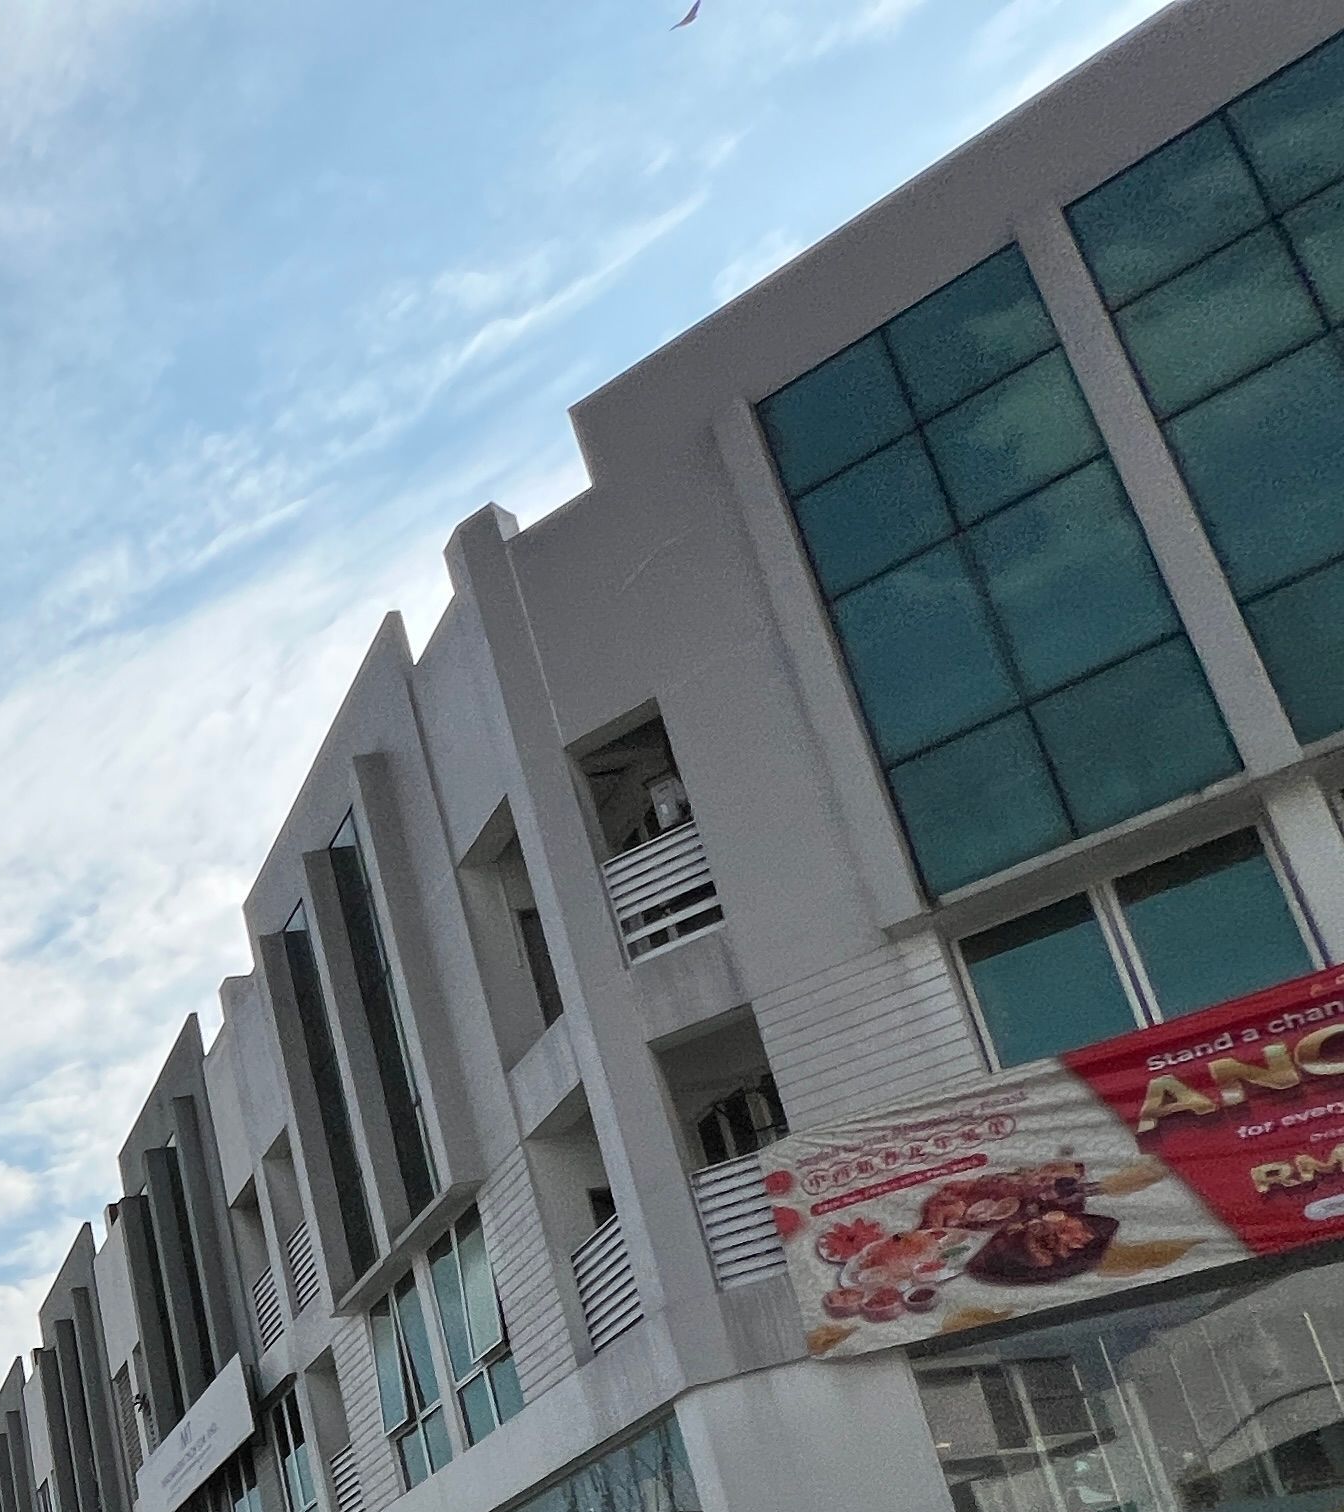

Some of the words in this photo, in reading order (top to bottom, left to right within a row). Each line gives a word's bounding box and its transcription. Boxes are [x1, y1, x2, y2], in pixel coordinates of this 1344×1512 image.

[1146, 1031, 1235, 1072] Stand
[1241, 1027, 1259, 1042] a
[1237, 1121, 1275, 1139] for
